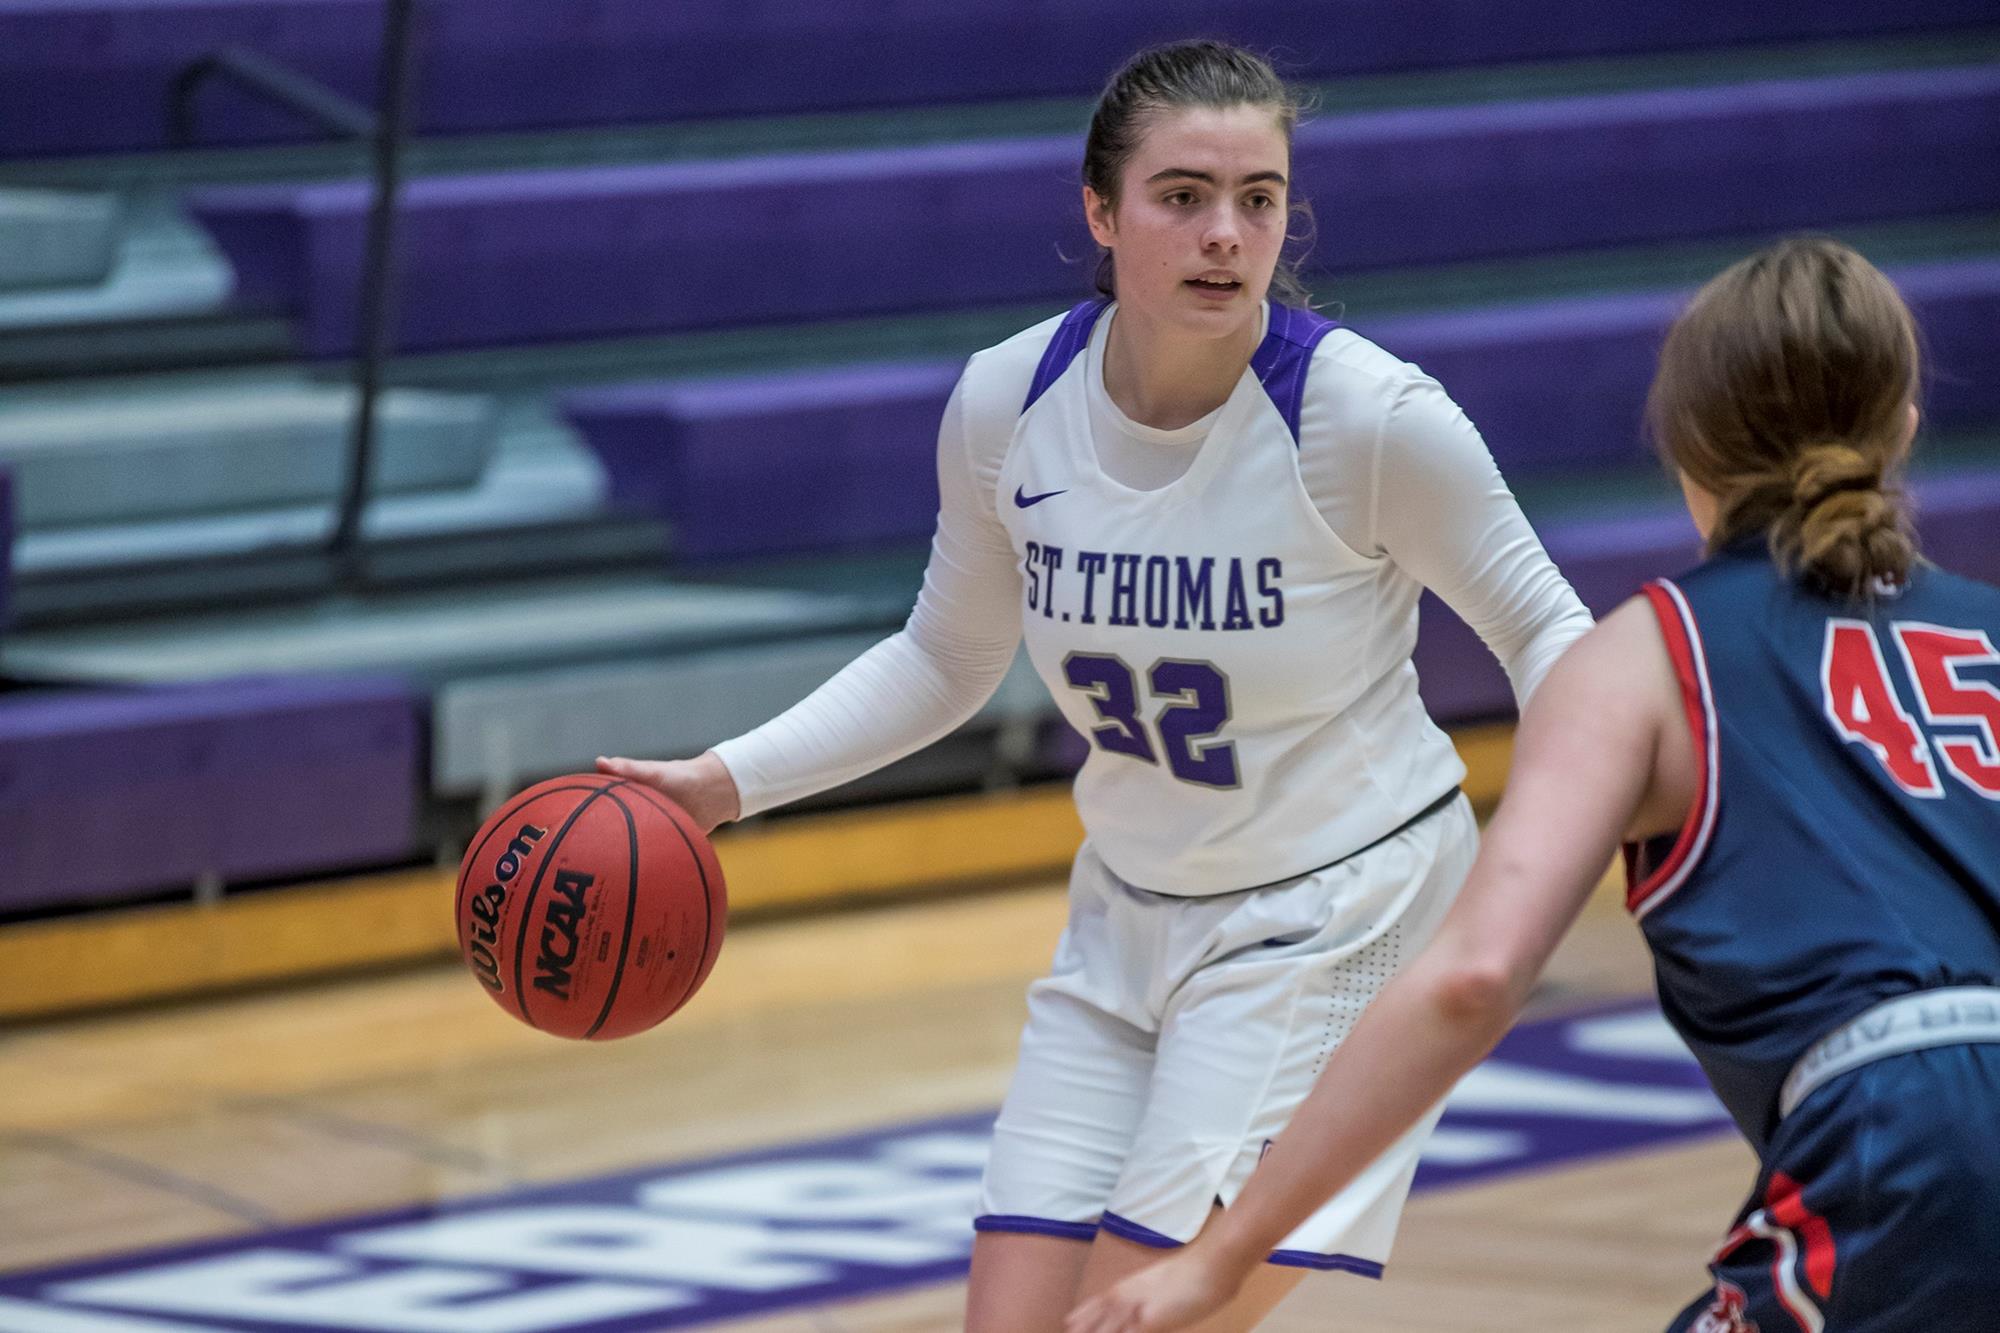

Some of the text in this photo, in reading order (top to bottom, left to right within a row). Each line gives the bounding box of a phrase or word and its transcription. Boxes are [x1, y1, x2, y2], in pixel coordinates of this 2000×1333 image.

[1060, 650, 1244, 791] 32
[1819, 616, 2000, 801] 45
[470, 823, 549, 994] Wilson
[533, 868, 595, 1000] NCAA
